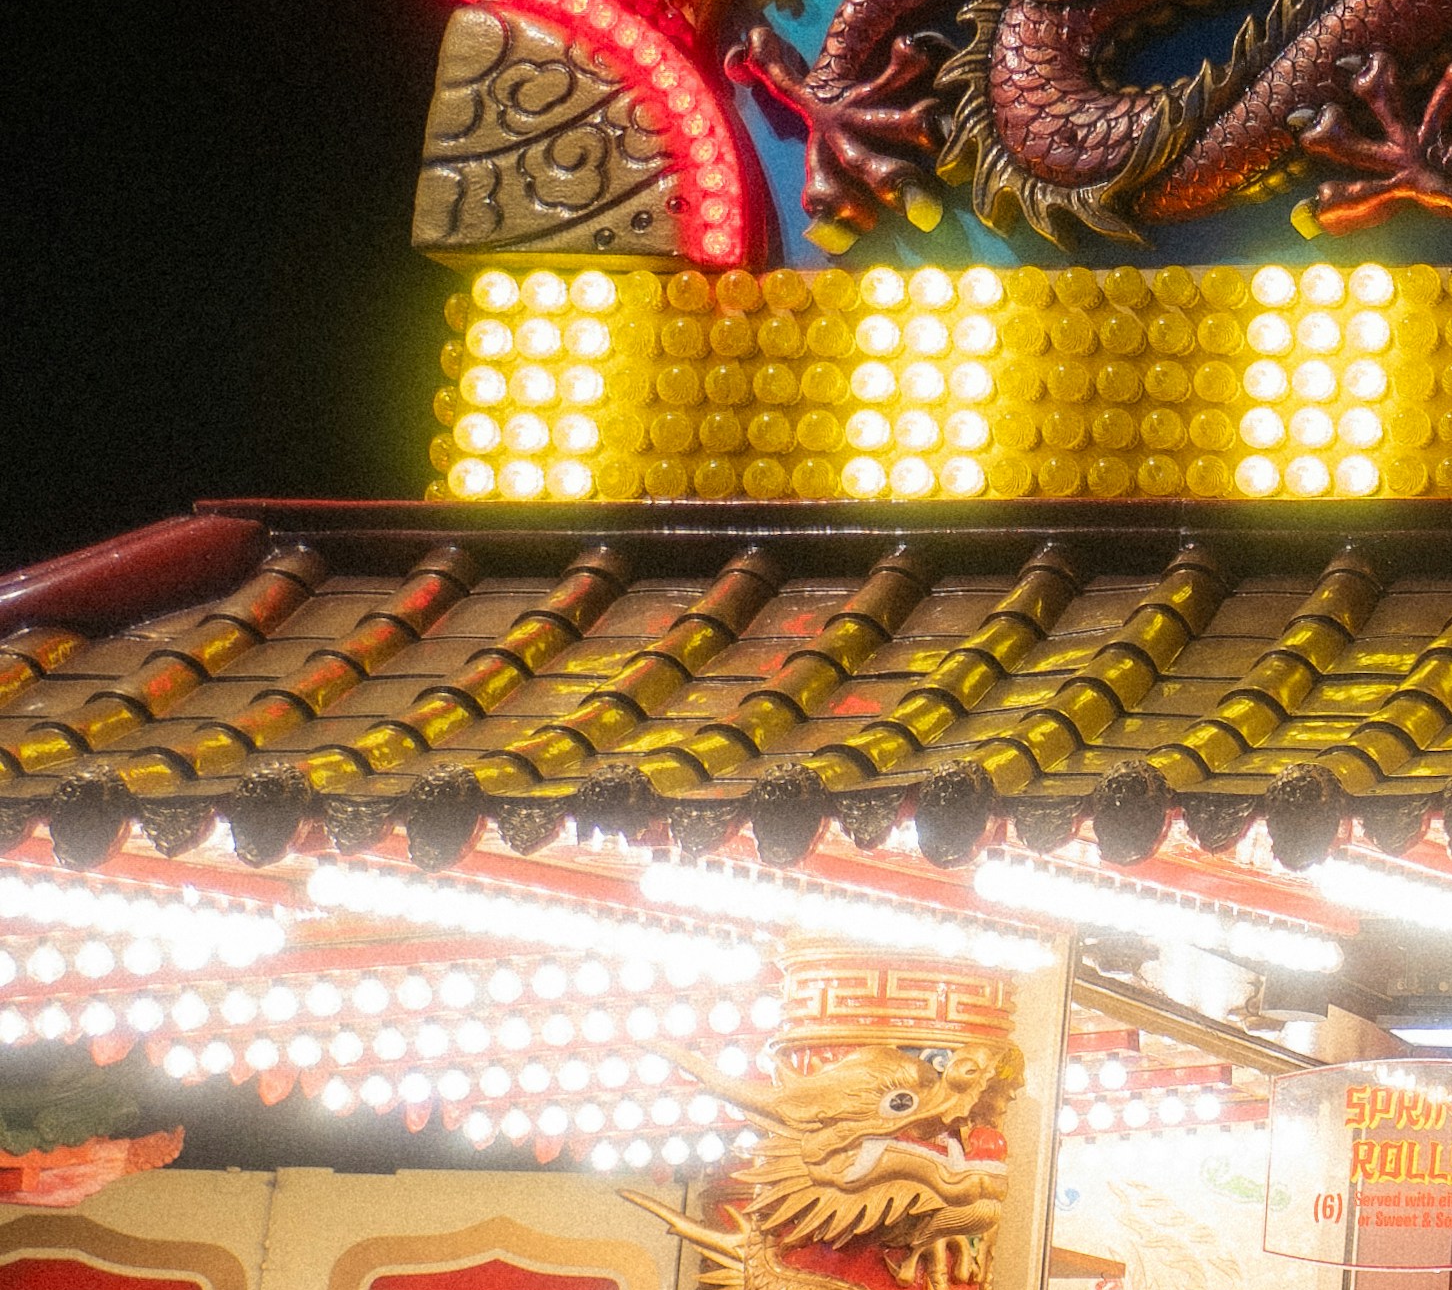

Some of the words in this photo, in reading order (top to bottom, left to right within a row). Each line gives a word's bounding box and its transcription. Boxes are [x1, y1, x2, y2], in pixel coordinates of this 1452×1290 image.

[1355, 1191, 1400, 1207] Served
[1405, 1192, 1434, 1207] with
[1313, 1192, 1343, 1224] (6)
[1358, 1215, 1371, 1227] or
[1375, 1211, 1418, 1228] Sweet
[1421, 1211, 1431, 1228] &
